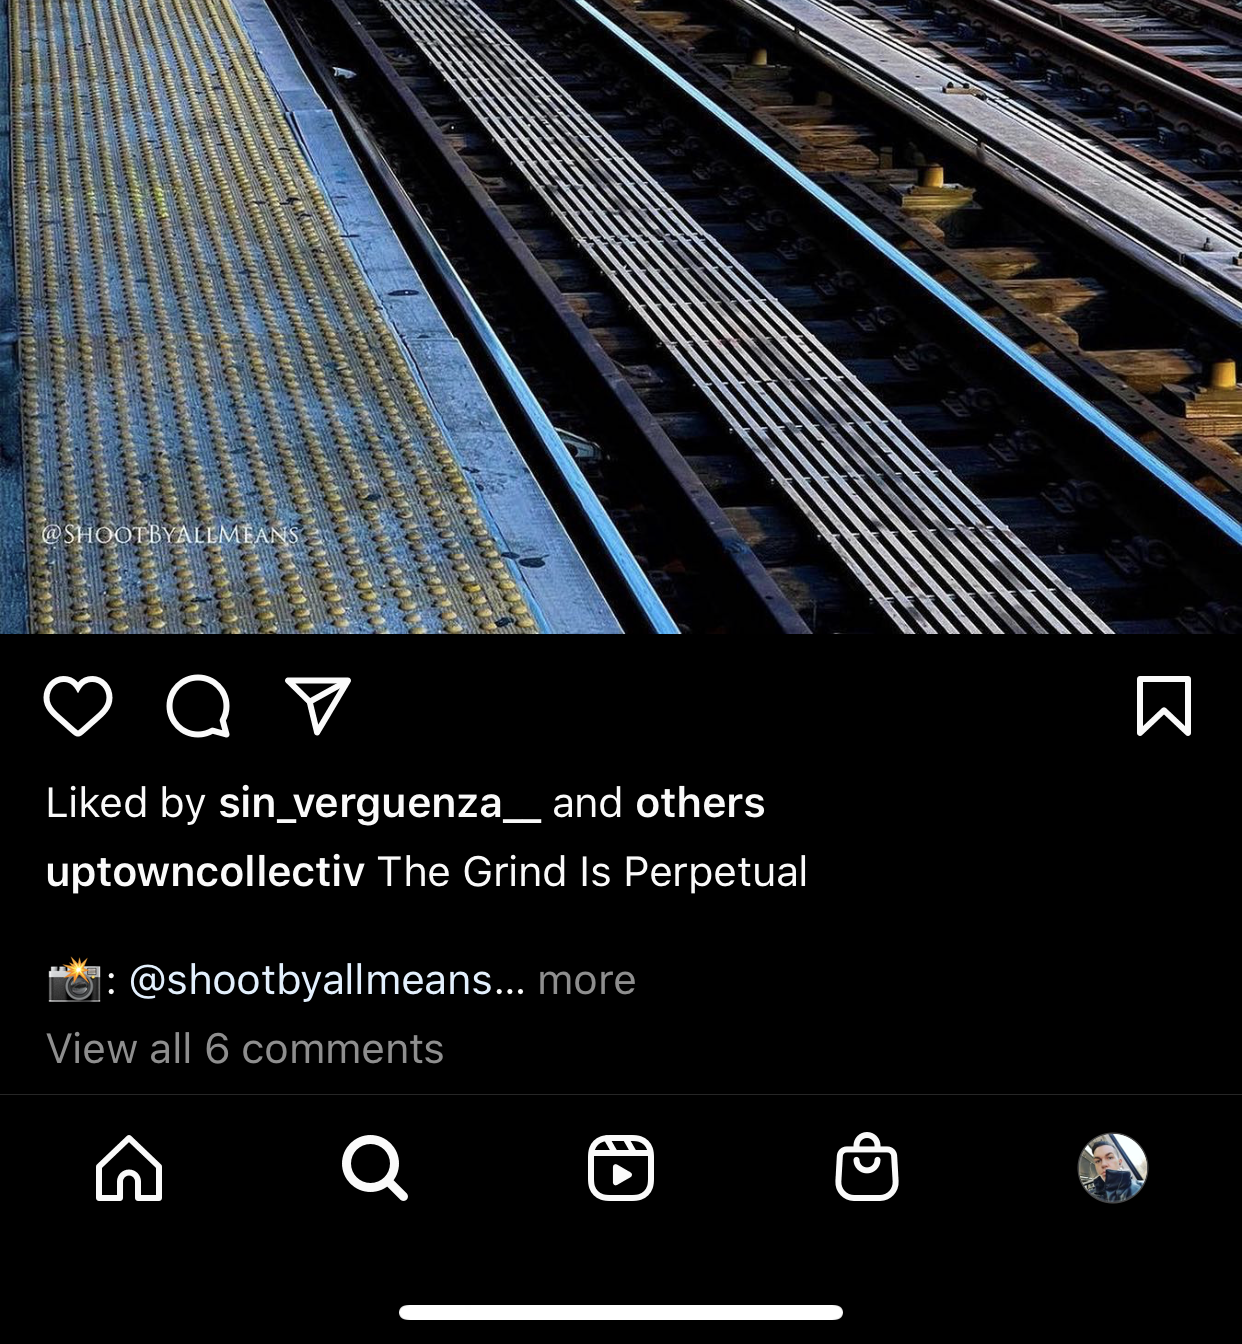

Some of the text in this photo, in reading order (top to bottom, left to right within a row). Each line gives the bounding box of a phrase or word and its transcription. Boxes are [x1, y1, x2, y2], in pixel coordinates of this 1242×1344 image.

[48, 785, 764, 826] Liked by sin_verguenza__ and others
[48, 854, 805, 894] uptowncollectiv The Grind Is Perpetual
[540, 971, 635, 994] more
[47, 1032, 443, 1064] View all 6 comments
